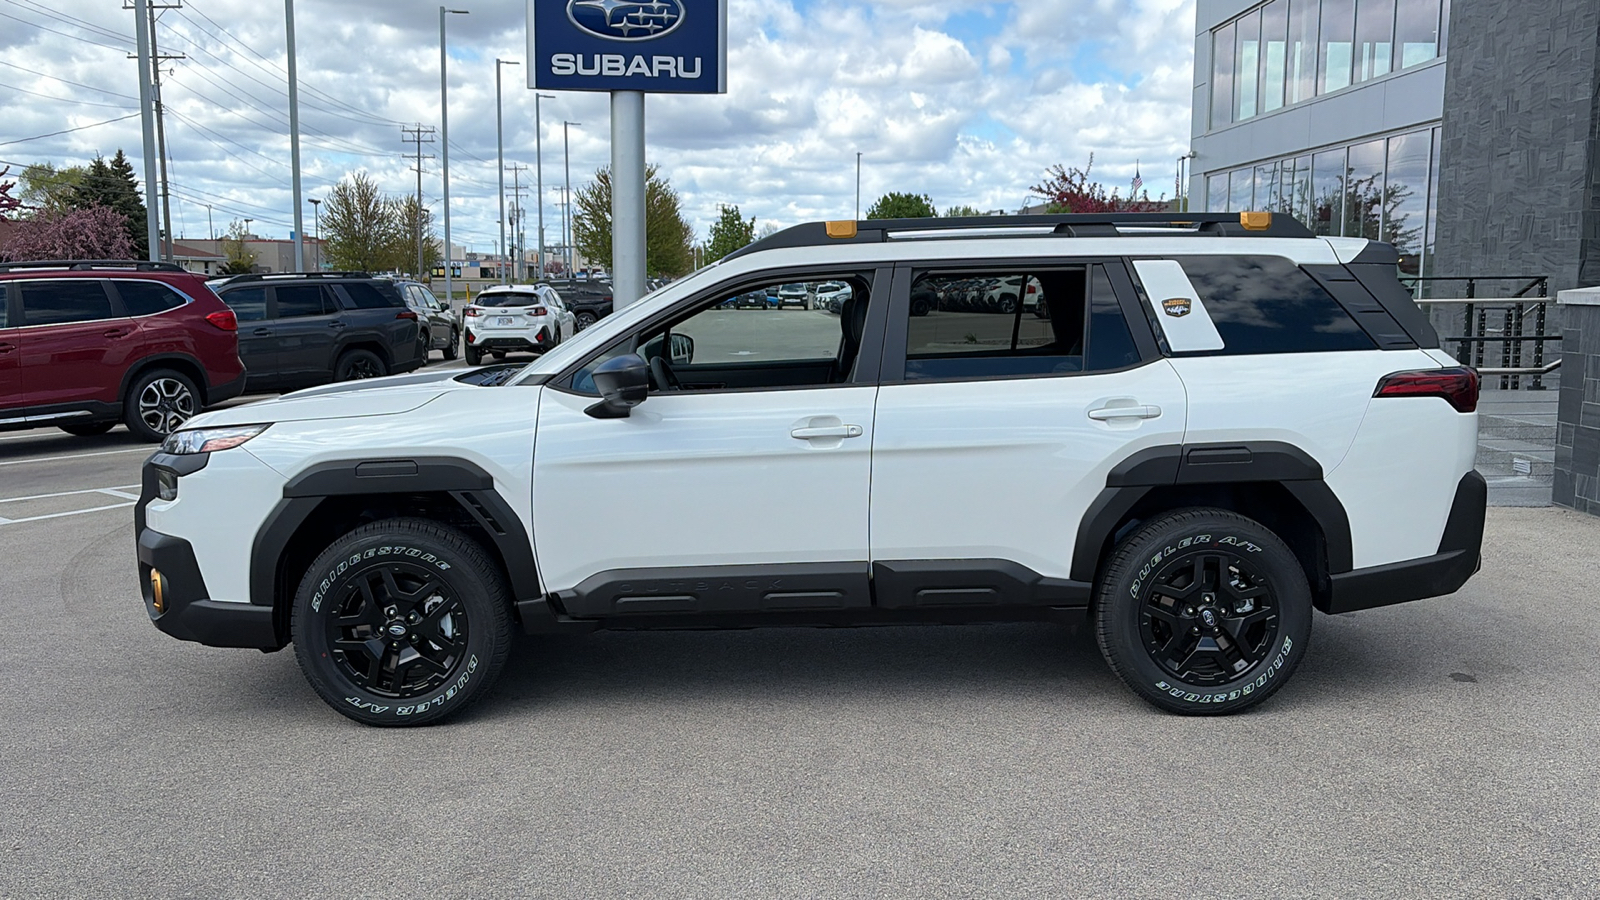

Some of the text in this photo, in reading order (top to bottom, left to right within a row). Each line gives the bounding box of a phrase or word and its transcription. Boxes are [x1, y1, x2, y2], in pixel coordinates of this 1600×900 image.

[551, 53, 702, 79] SUBARU
[311, 546, 451, 613] BRIDGESTONE
[619, 579, 783, 593] OUTBACK
[1129, 534, 1262, 599] DUELER A/T
[345, 654, 479, 716] DUELER A/T
[1155, 635, 1293, 704] BRIDGESTONE
